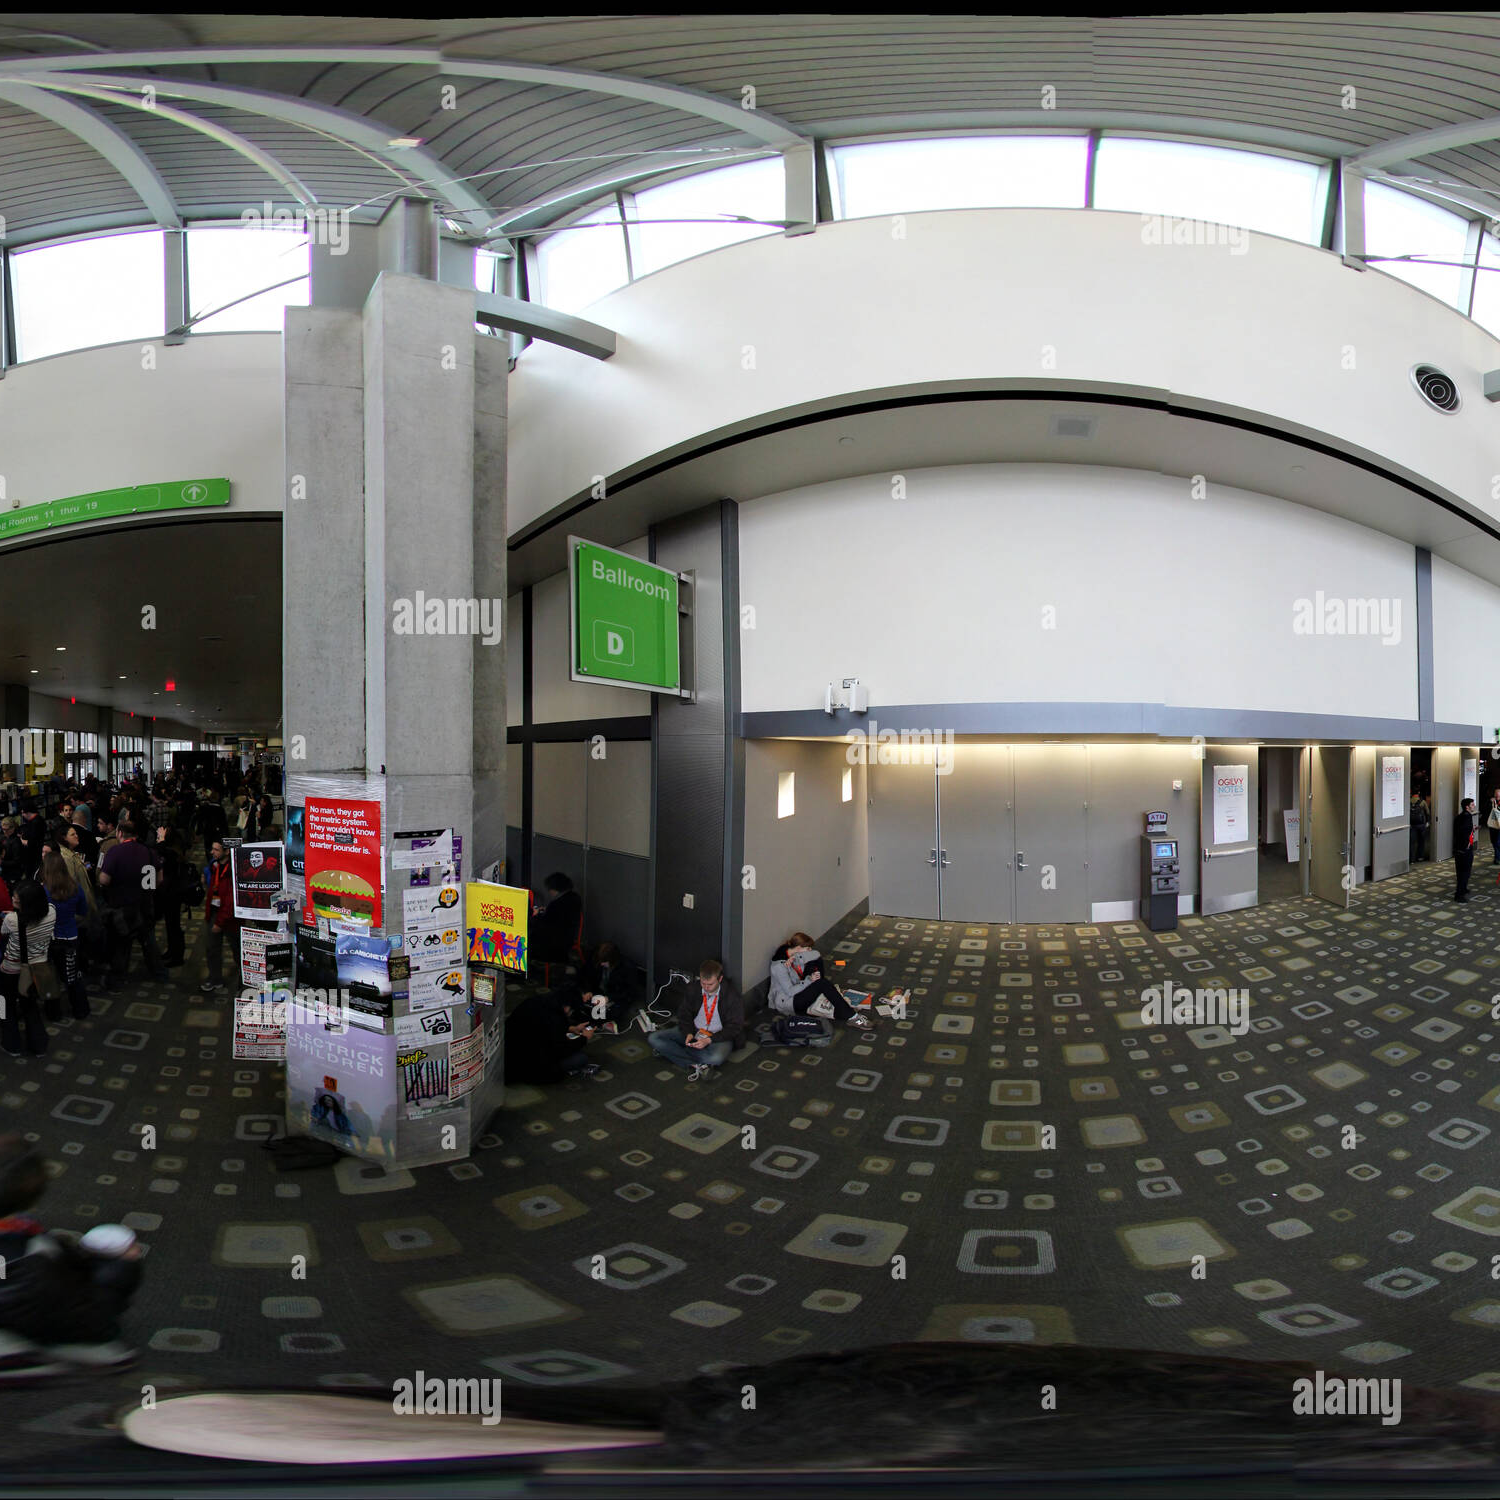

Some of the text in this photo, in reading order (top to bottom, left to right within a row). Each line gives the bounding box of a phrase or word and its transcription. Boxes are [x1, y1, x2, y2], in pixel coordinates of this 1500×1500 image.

[8, 515, 39, 527] Rooms
[44, 510, 54, 519] 11
[60, 505, 80, 516] thru
[86, 501, 98, 511] 19
[592, 560, 670, 602] Ballroom
[607, 631, 624, 656] D
[1217, 778, 1244, 786] OGILVY
[1217, 785, 1244, 793] NOTES
[320, 807, 336, 815] man,
[337, 808, 351, 817] they
[352, 810, 365, 818] got
[309, 814, 369, 827] the metric system.
[309, 822, 376, 837] They wouldn't know
[309, 832, 325, 840] what
[309, 841, 371, 855] quarter pounder is.
[480, 902, 514, 915] WONDER
[349, 949, 388, 962] CAMIONETA
[288, 1024, 384, 1067] ELECTRICK
[288, 1037, 385, 1078] CHILDREN
